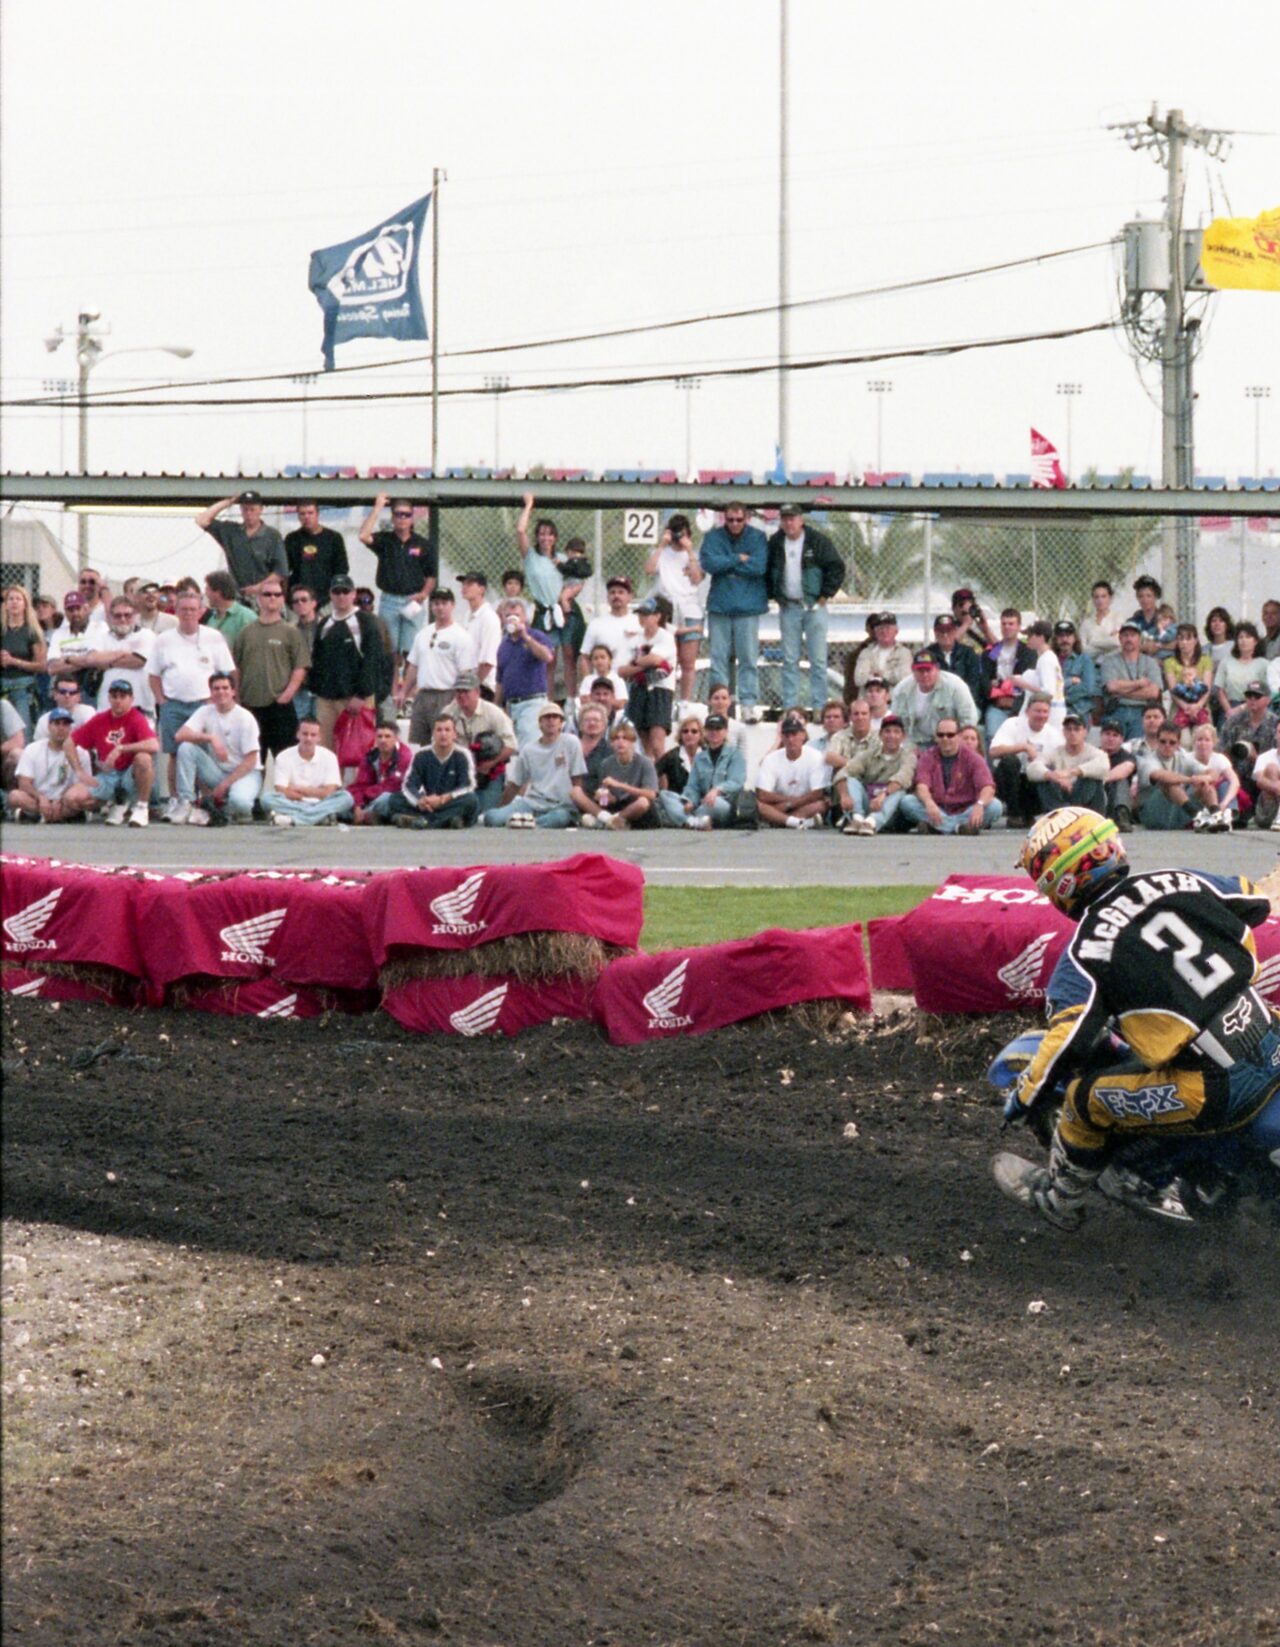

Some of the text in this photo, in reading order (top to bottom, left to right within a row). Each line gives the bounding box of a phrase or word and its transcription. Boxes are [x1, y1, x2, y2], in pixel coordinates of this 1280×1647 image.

[628, 513, 654, 538] 22
[431, 920, 488, 936] HONDA
[1140, 911, 1236, 999] 2
